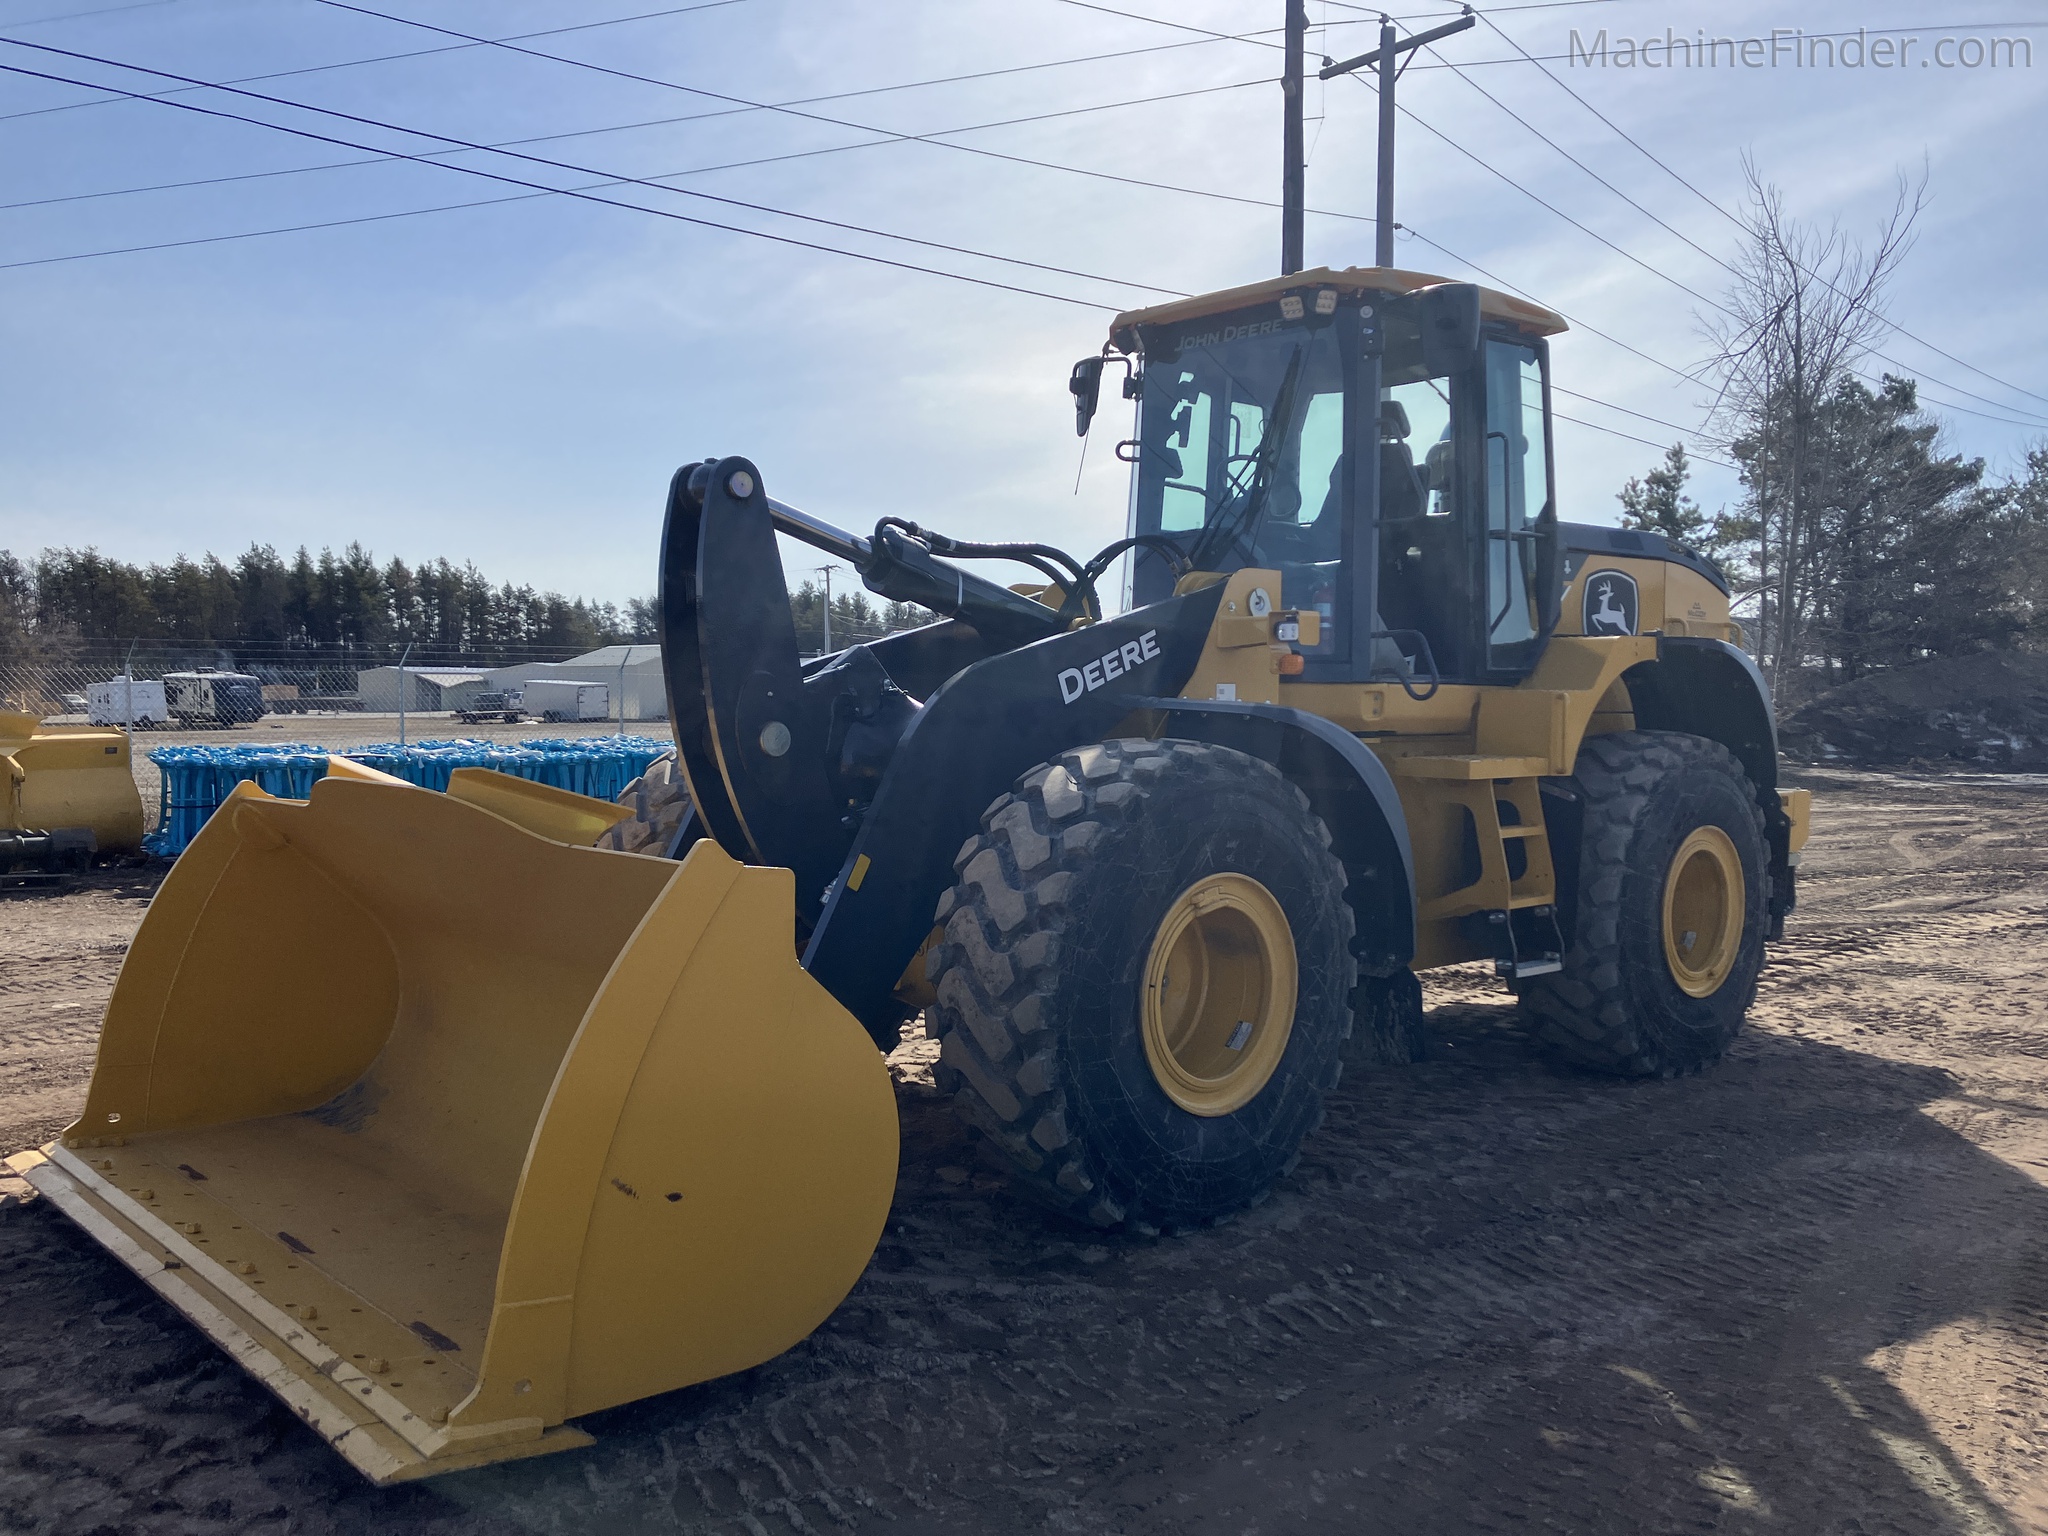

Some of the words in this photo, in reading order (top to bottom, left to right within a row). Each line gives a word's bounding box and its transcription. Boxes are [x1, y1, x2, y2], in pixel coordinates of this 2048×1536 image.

[1174, 331, 1220, 352] JOHN
[1223, 319, 1283, 342] DEERE
[1057, 629, 1161, 705] DEERE
